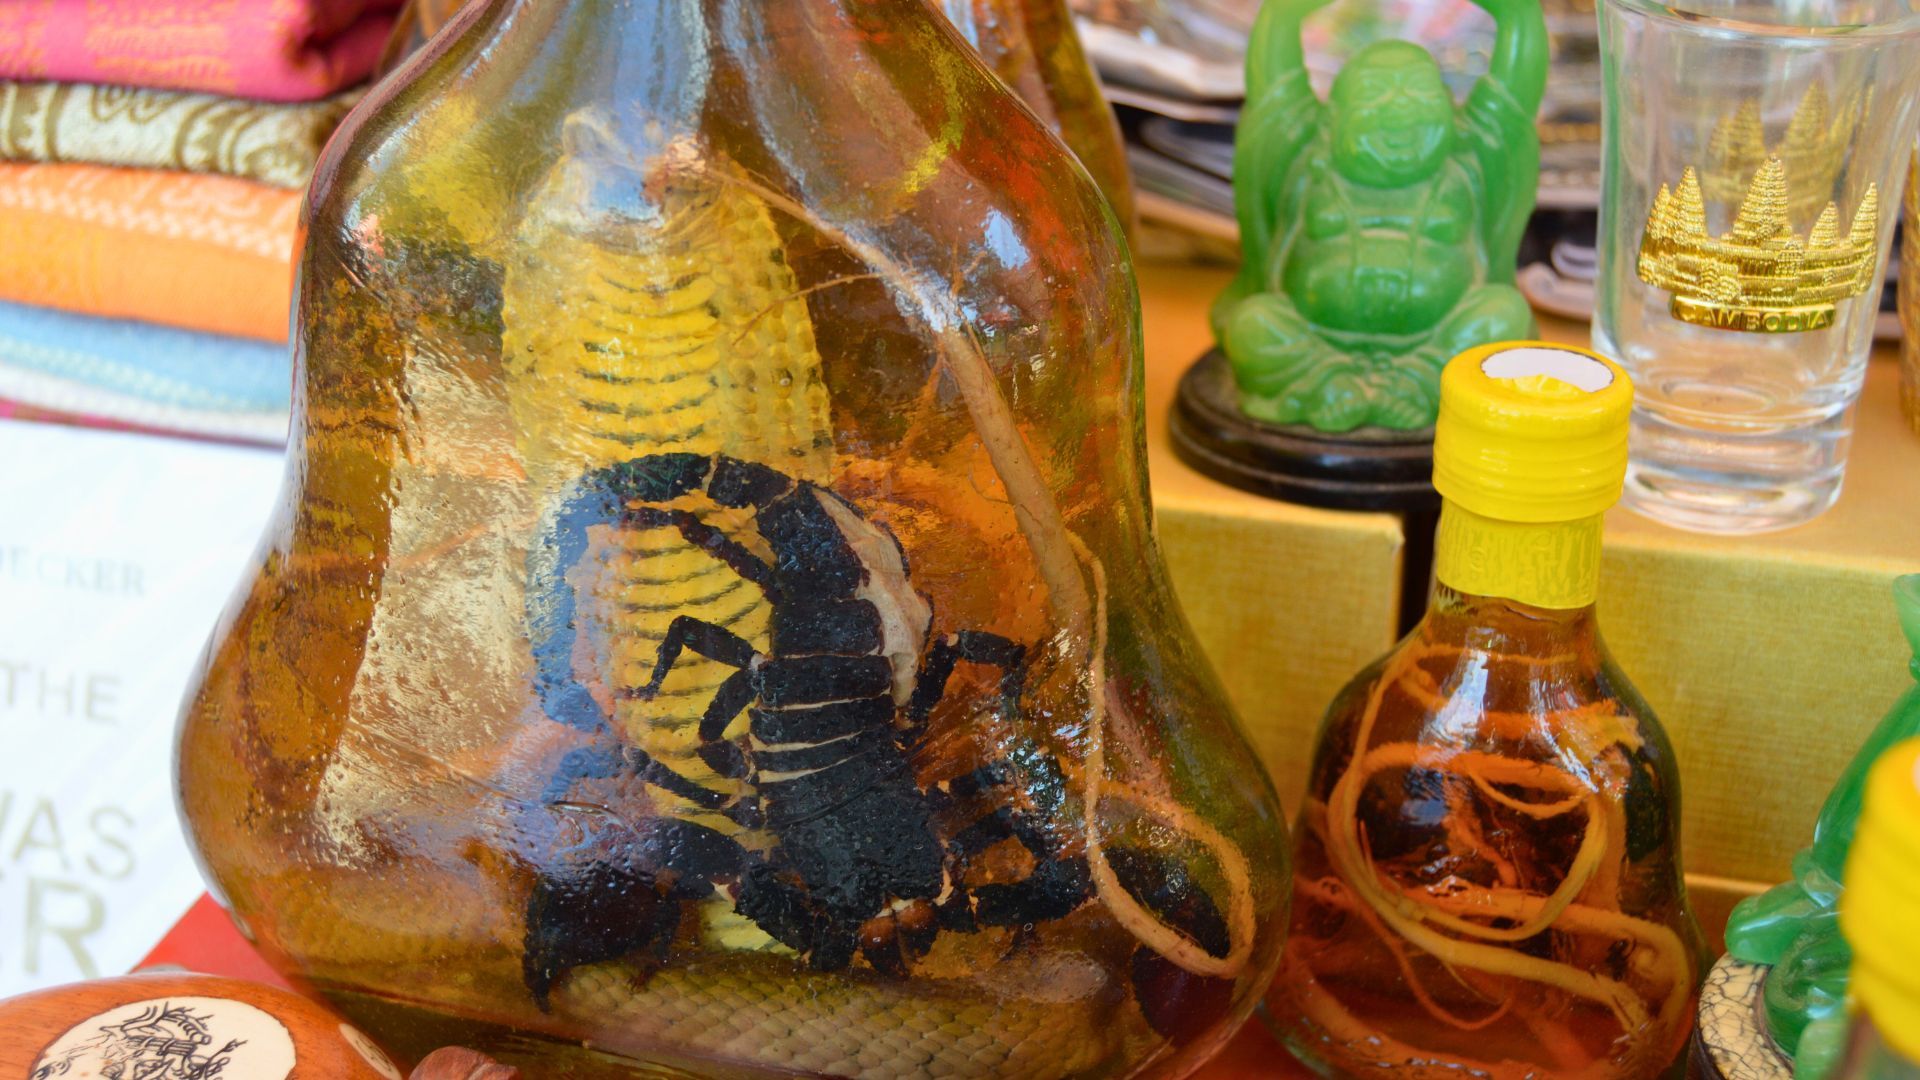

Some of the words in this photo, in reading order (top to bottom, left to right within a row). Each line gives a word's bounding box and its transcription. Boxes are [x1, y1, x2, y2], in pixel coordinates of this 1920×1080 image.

[1679, 304, 1831, 331] CAMBODIA
[0, 544, 146, 596] ECKER
[0, 658, 122, 726] THE
[0, 789, 137, 880] AS
[0, 868, 107, 979] R
